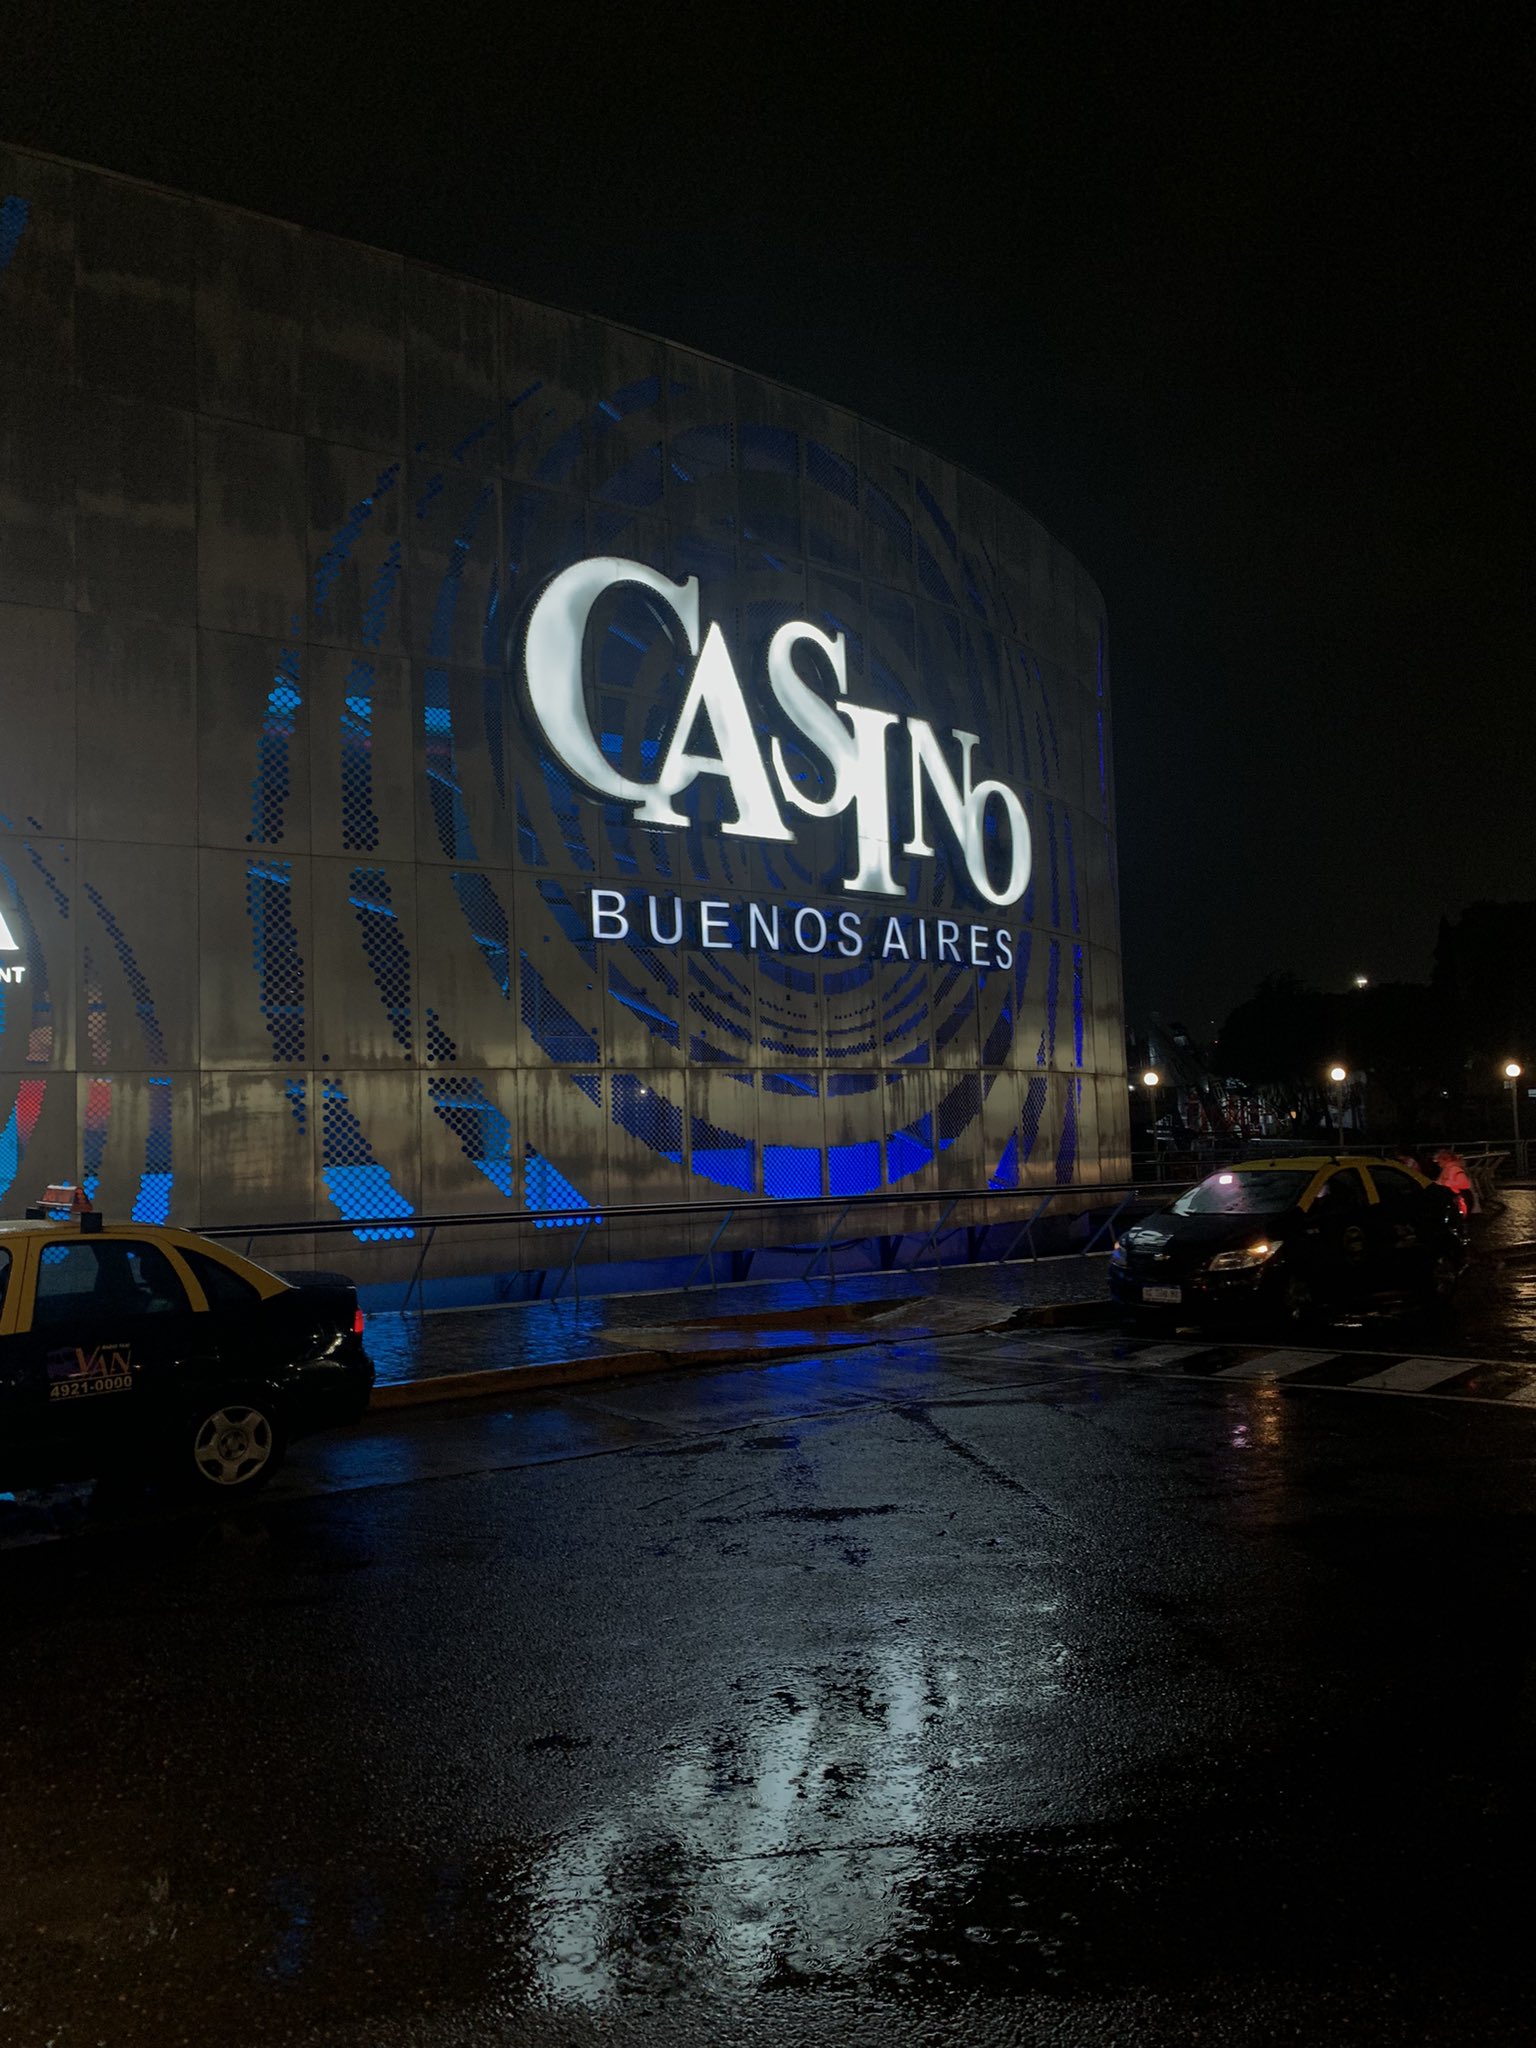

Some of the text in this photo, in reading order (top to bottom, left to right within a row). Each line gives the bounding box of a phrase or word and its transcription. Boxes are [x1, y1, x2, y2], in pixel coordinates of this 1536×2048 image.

[525, 556, 1032, 906] CASINO
[591, 889, 1013, 971] BUENOS AIRES
[50, 1375, 133, 1398] 4921-0000
[75, 1344, 132, 1377] VAN
